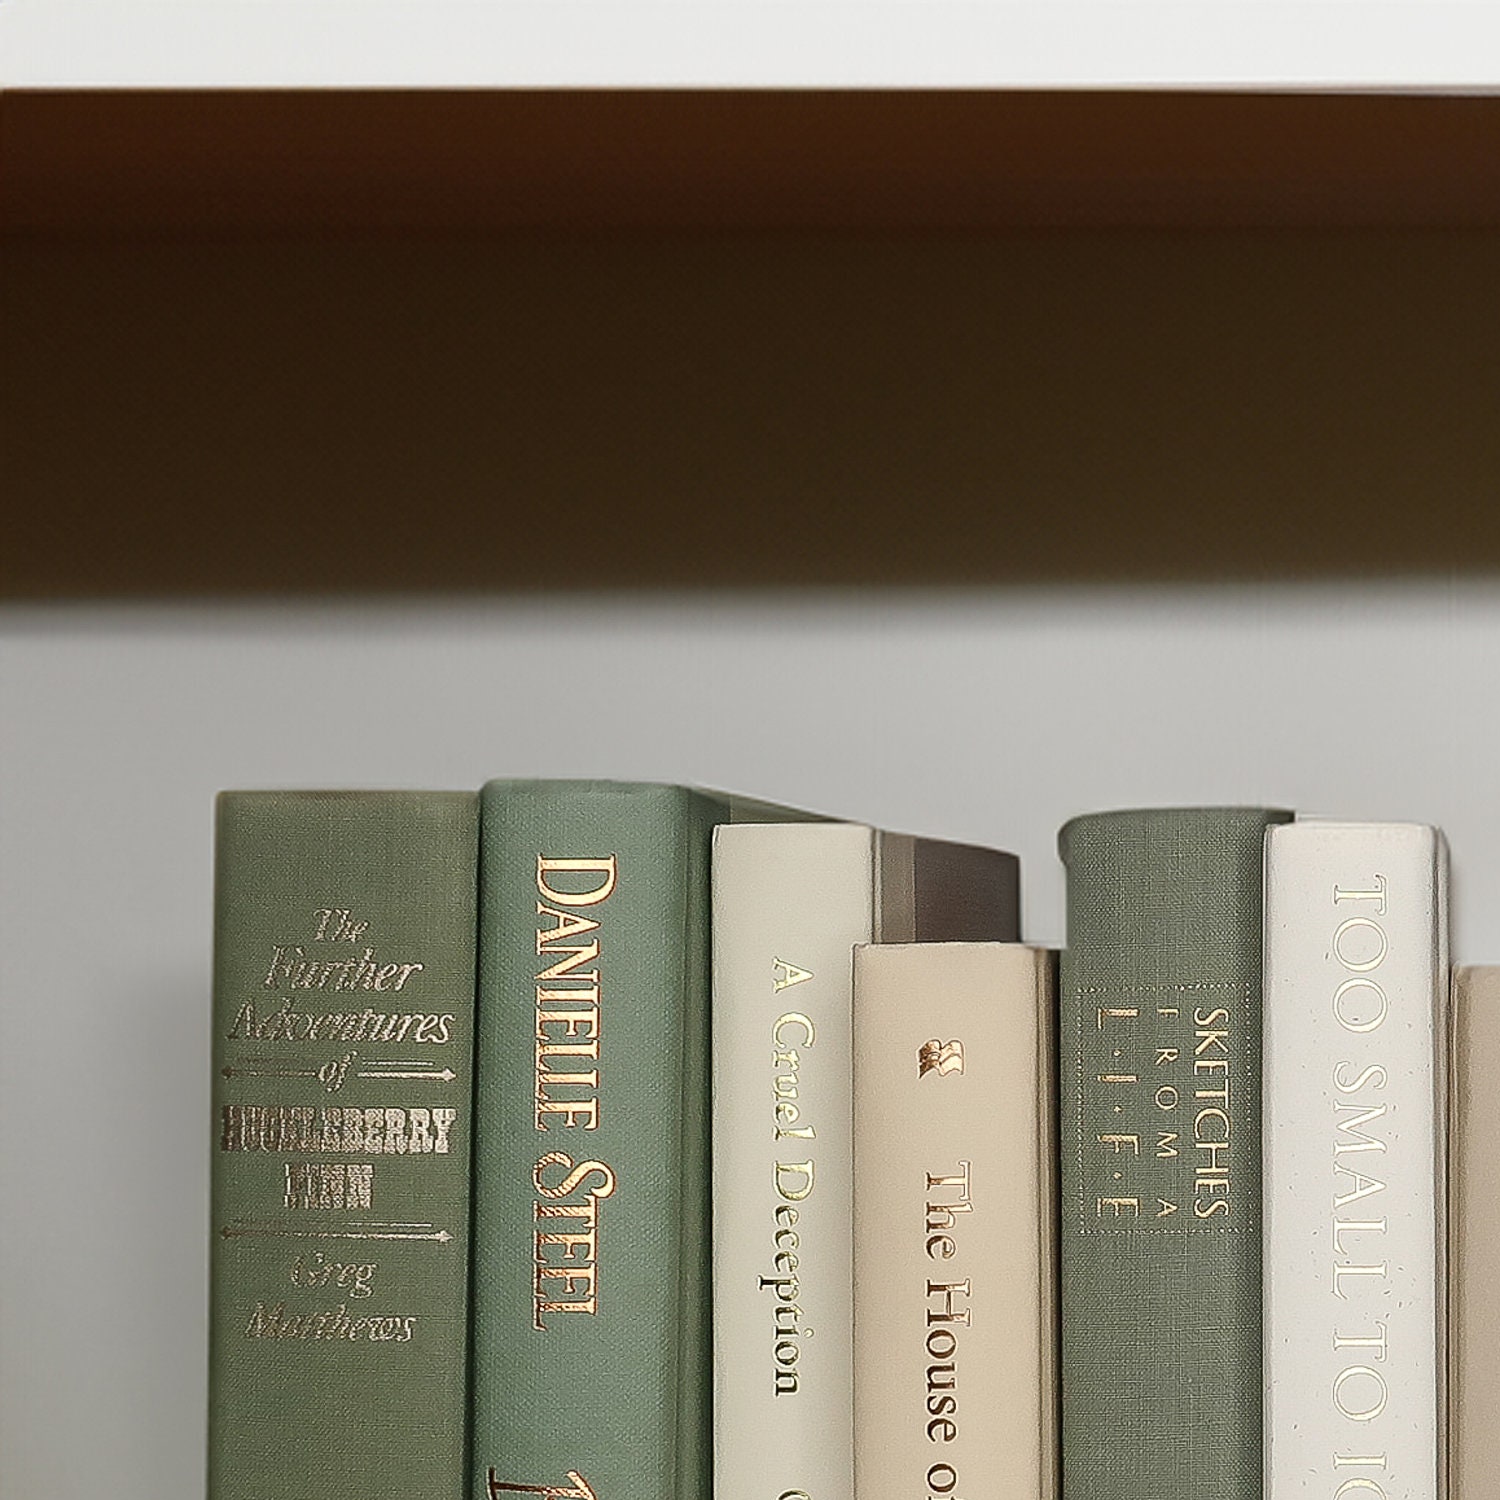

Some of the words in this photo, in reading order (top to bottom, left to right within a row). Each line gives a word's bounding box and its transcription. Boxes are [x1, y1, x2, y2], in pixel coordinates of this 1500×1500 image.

[263, 945, 424, 992] Further
[312, 906, 370, 943] The
[772, 957, 815, 994] A
[1331, 872, 1389, 1034] TOO
[226, 997, 456, 1044] Adventures
[532, 852, 618, 1134] DANIELLE
[318, 1050, 358, 1092] of
[771, 1011, 817, 1142] Cruel
[1193, 1007, 1230, 1220] SKETCHES
[925, 1161, 974, 1260] The
[1331, 1060, 1388, 1300] SMALL
[290, 1251, 379, 1299] Greg
[532, 1150, 617, 1331] STEEL
[758, 1160, 816, 1398] Deception
[925, 1278, 971, 1442] House
[1331, 1321, 1389, 1422] TO
